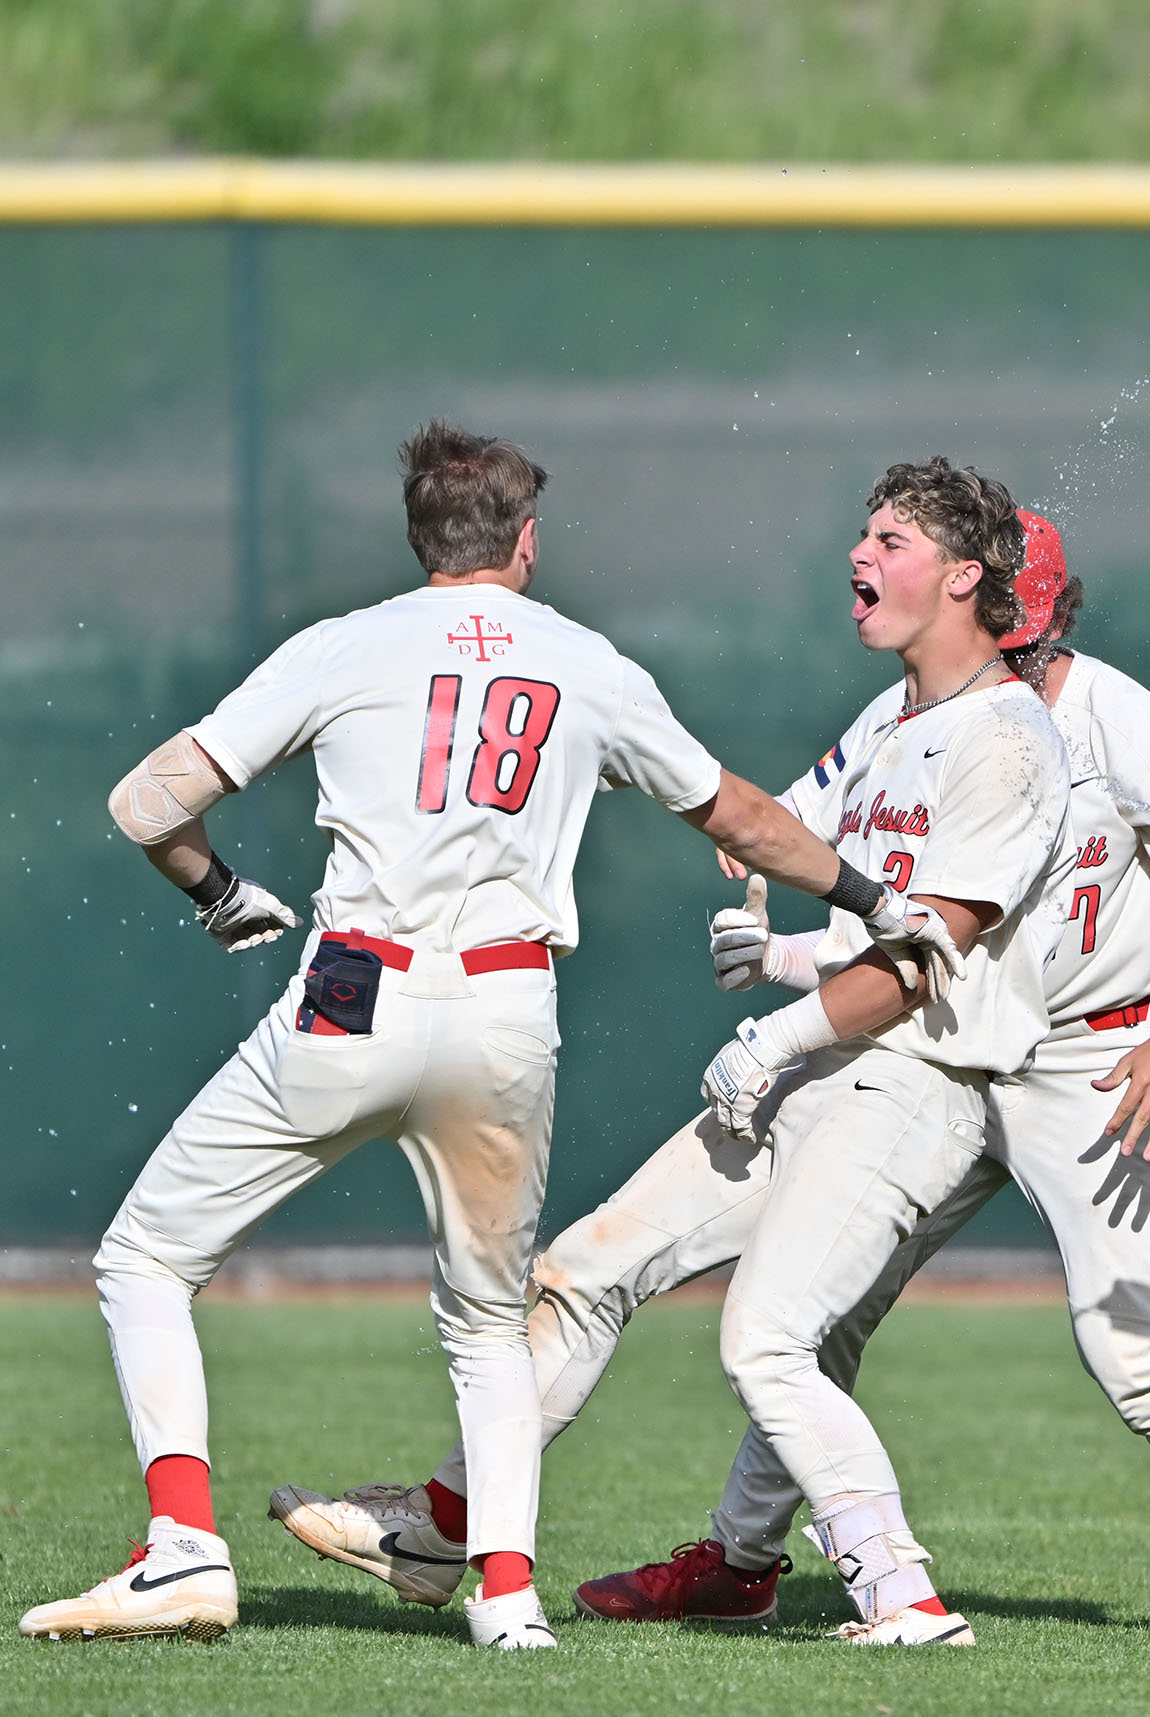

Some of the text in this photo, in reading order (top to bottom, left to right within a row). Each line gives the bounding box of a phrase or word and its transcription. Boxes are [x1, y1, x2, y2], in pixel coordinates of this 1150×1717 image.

[456, 621, 503, 633] A M
[458, 643, 505, 656] D G
[415, 673, 562, 816] 18
[863, 789, 930, 841] Jesuit
[1051, 884, 1102, 961] 7
